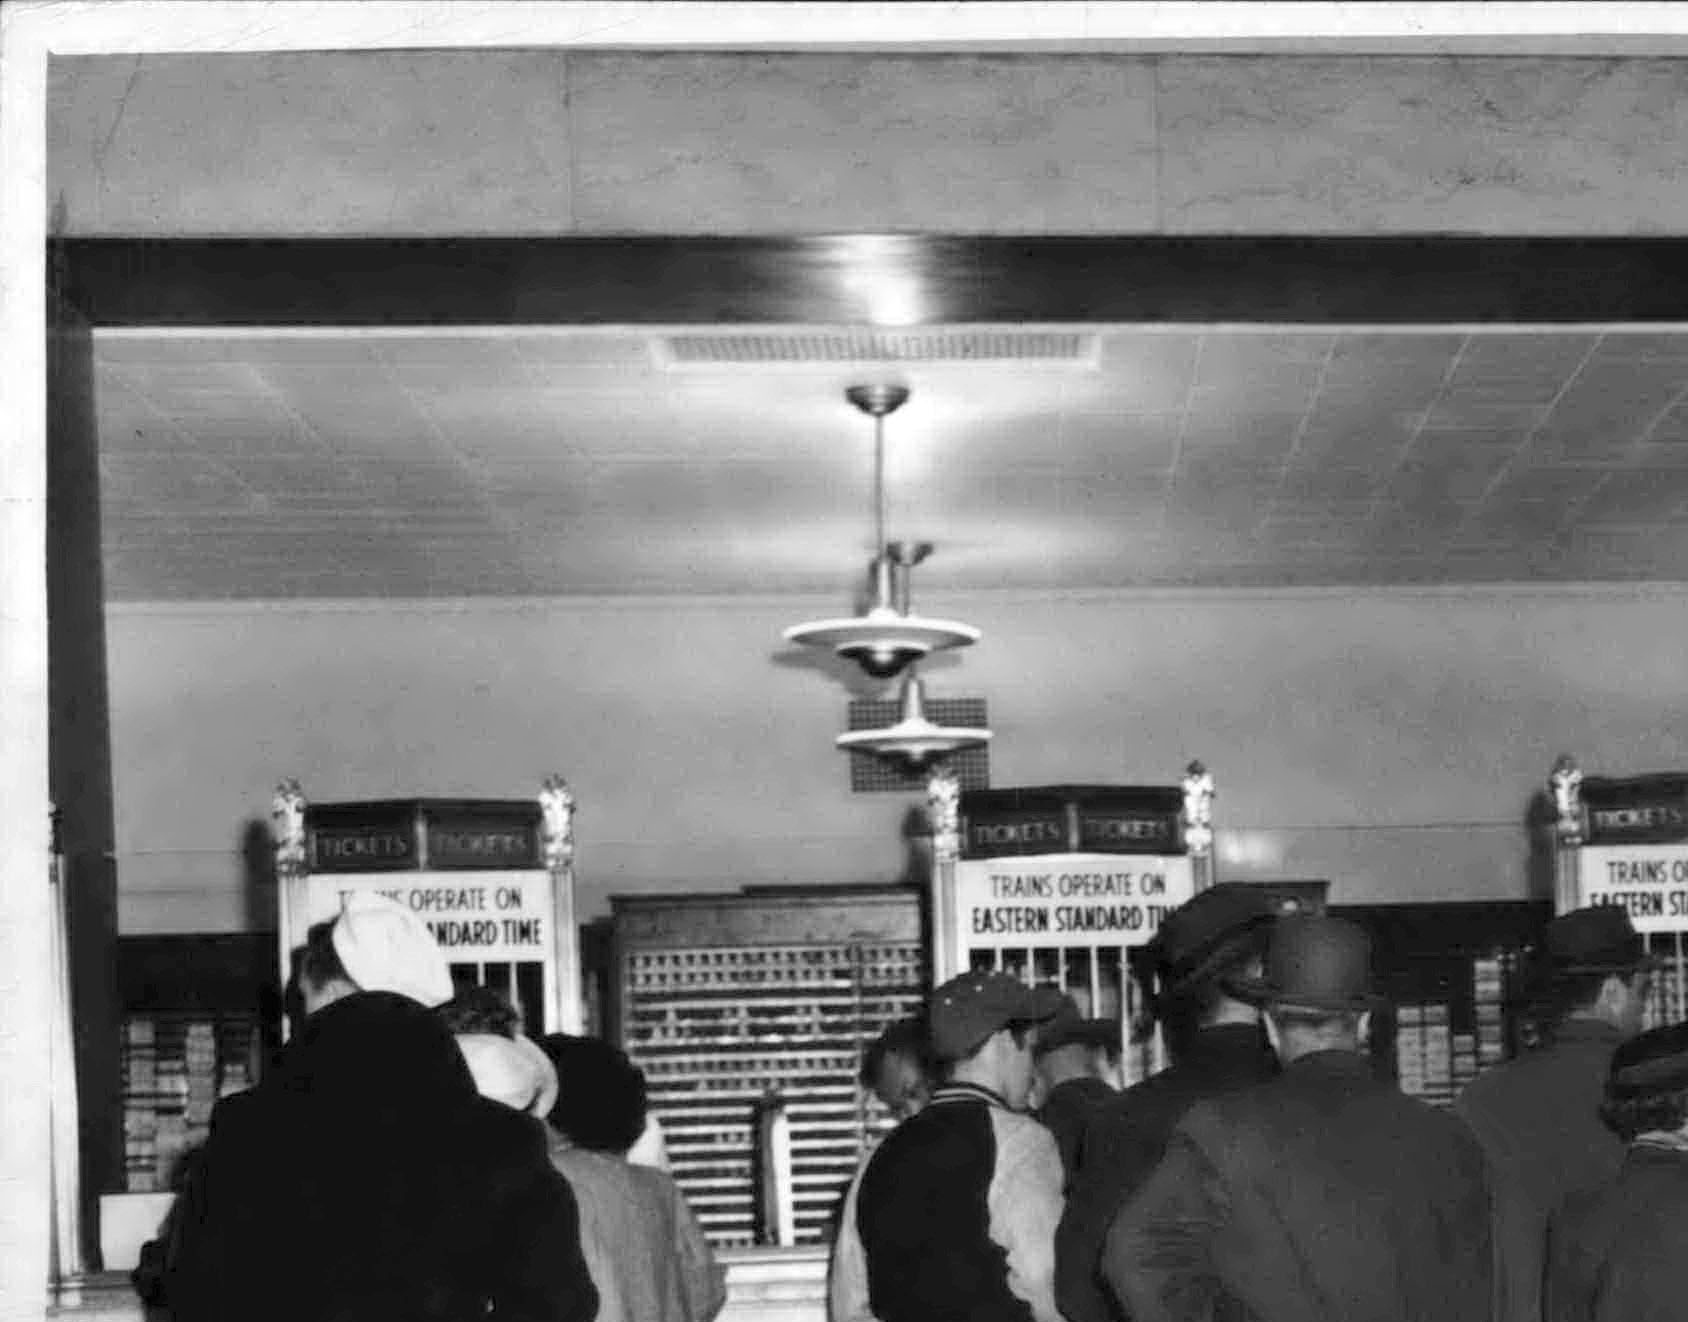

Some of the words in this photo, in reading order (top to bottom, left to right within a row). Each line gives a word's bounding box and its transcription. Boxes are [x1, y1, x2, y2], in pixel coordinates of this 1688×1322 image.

[1593, 807, 1681, 827] TICKETS
[319, 834, 408, 856] TICKETS
[975, 821, 1060, 844] TICKETS
[1606, 859, 1668, 884] TRAINS
[989, 873, 1053, 898] TRAINS
[1058, 873, 1132, 897] OPERATE
[1140, 872, 1166, 896] ON
[409, 888, 486, 912] OPERATE
[495, 887, 522, 911] ON
[502, 918, 542, 946] TIME
[972, 906, 1049, 934] EASTERN
[1055, 905, 1143, 932] STANDARD
